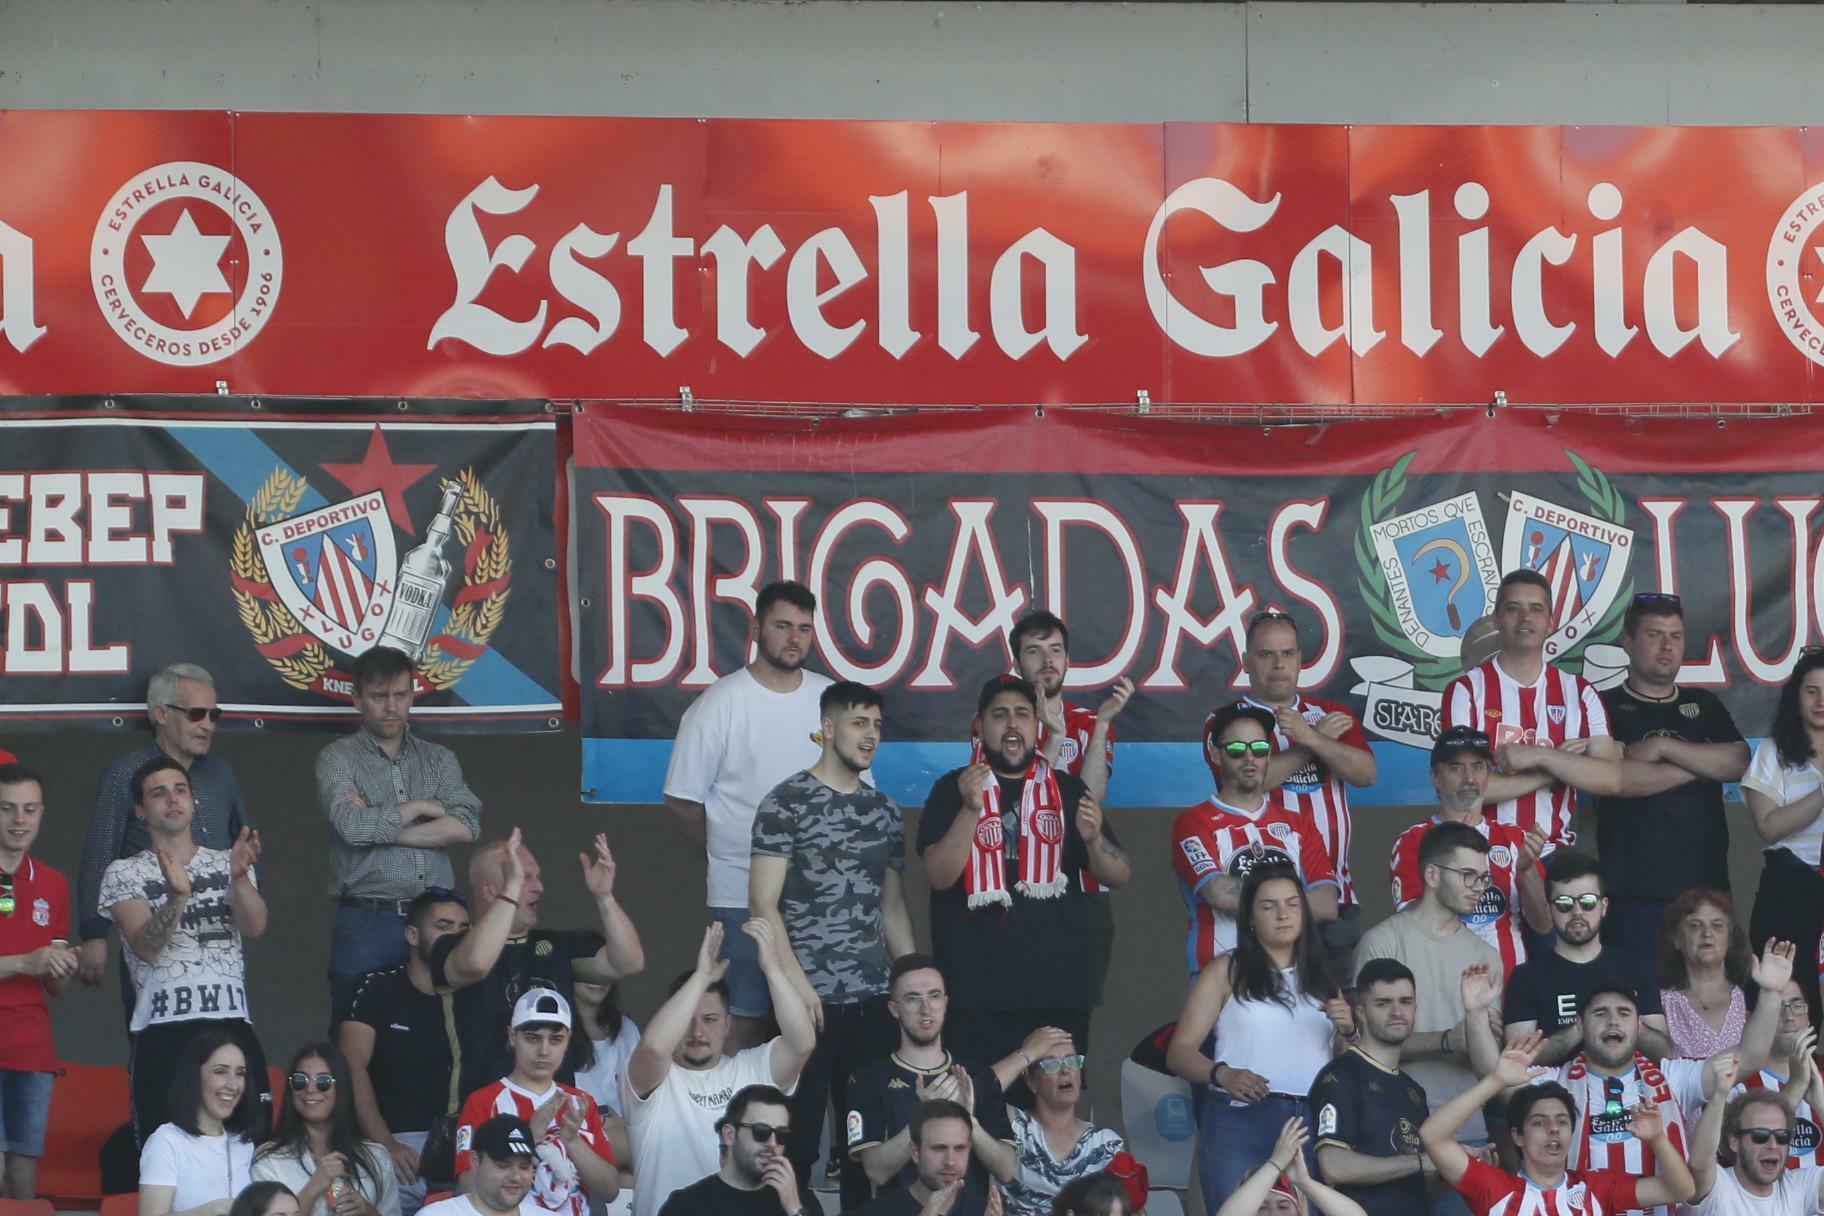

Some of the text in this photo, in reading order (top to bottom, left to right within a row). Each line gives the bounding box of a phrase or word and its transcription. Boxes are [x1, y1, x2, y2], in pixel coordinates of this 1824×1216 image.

[109, 173, 263, 234] ESTRELLA GALICIA
[428, 176, 1743, 361] Estrella Galicia
[101, 271, 273, 356] CERVECEROS DESDE 1906
[283, 498, 381, 538] DEPORTIVO
[1372, 509, 1440, 543] MORTOS
[1443, 496, 1476, 519] QVE
[1534, 506, 1629, 548] DEPORTIVO
[399, 582, 434, 609] VODKA
[594, 493, 1344, 690] BRIGADAS
[1383, 557, 1430, 648] DENANTES
